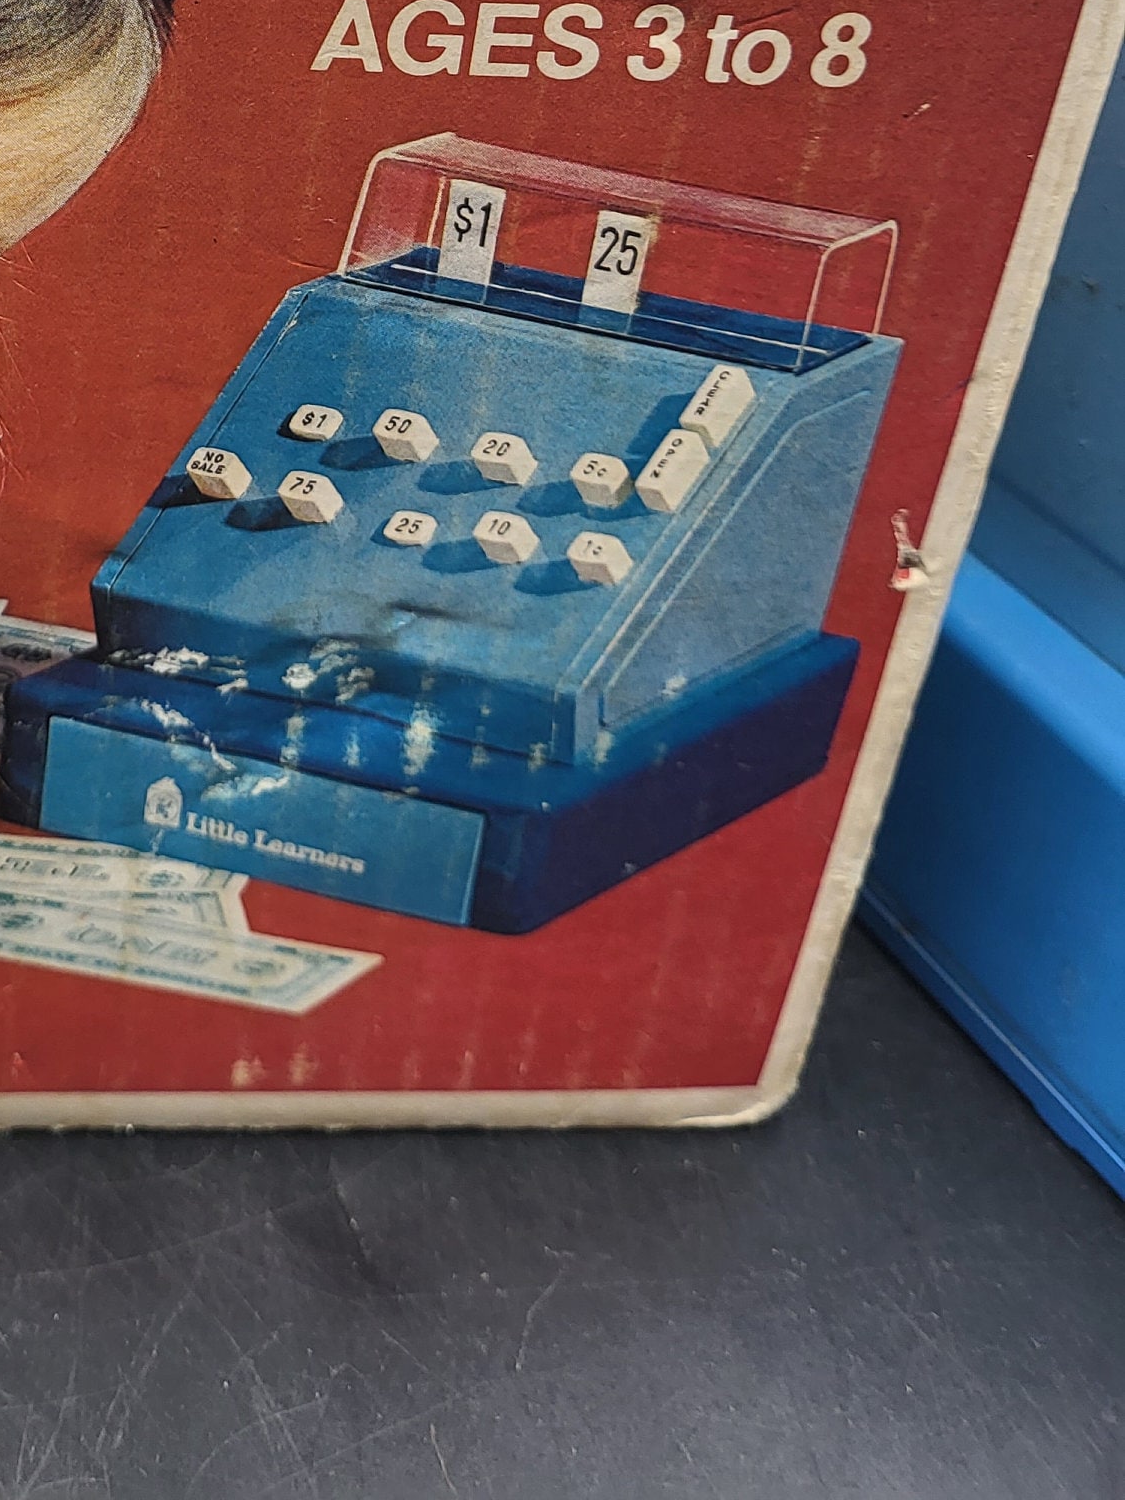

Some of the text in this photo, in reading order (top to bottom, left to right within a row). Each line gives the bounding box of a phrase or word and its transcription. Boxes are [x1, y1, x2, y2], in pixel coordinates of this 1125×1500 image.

[625, 3, 687, 83] 3
[704, 14, 793, 87] to
[809, 11, 873, 89] 8
[453, 197, 493, 248] $1
[593, 225, 643, 276] 25
[301, 411, 329, 429] $1
[383, 415, 413, 435] 50
[190, 459, 226, 475] SALE
[202, 451, 225, 464] NO
[649, 437, 683, 479] OPEN
[288, 476, 317, 496] 75
[394, 517, 423, 535] 25
[487, 518, 512, 537] 10
[186, 811, 366, 875] Little Learners
